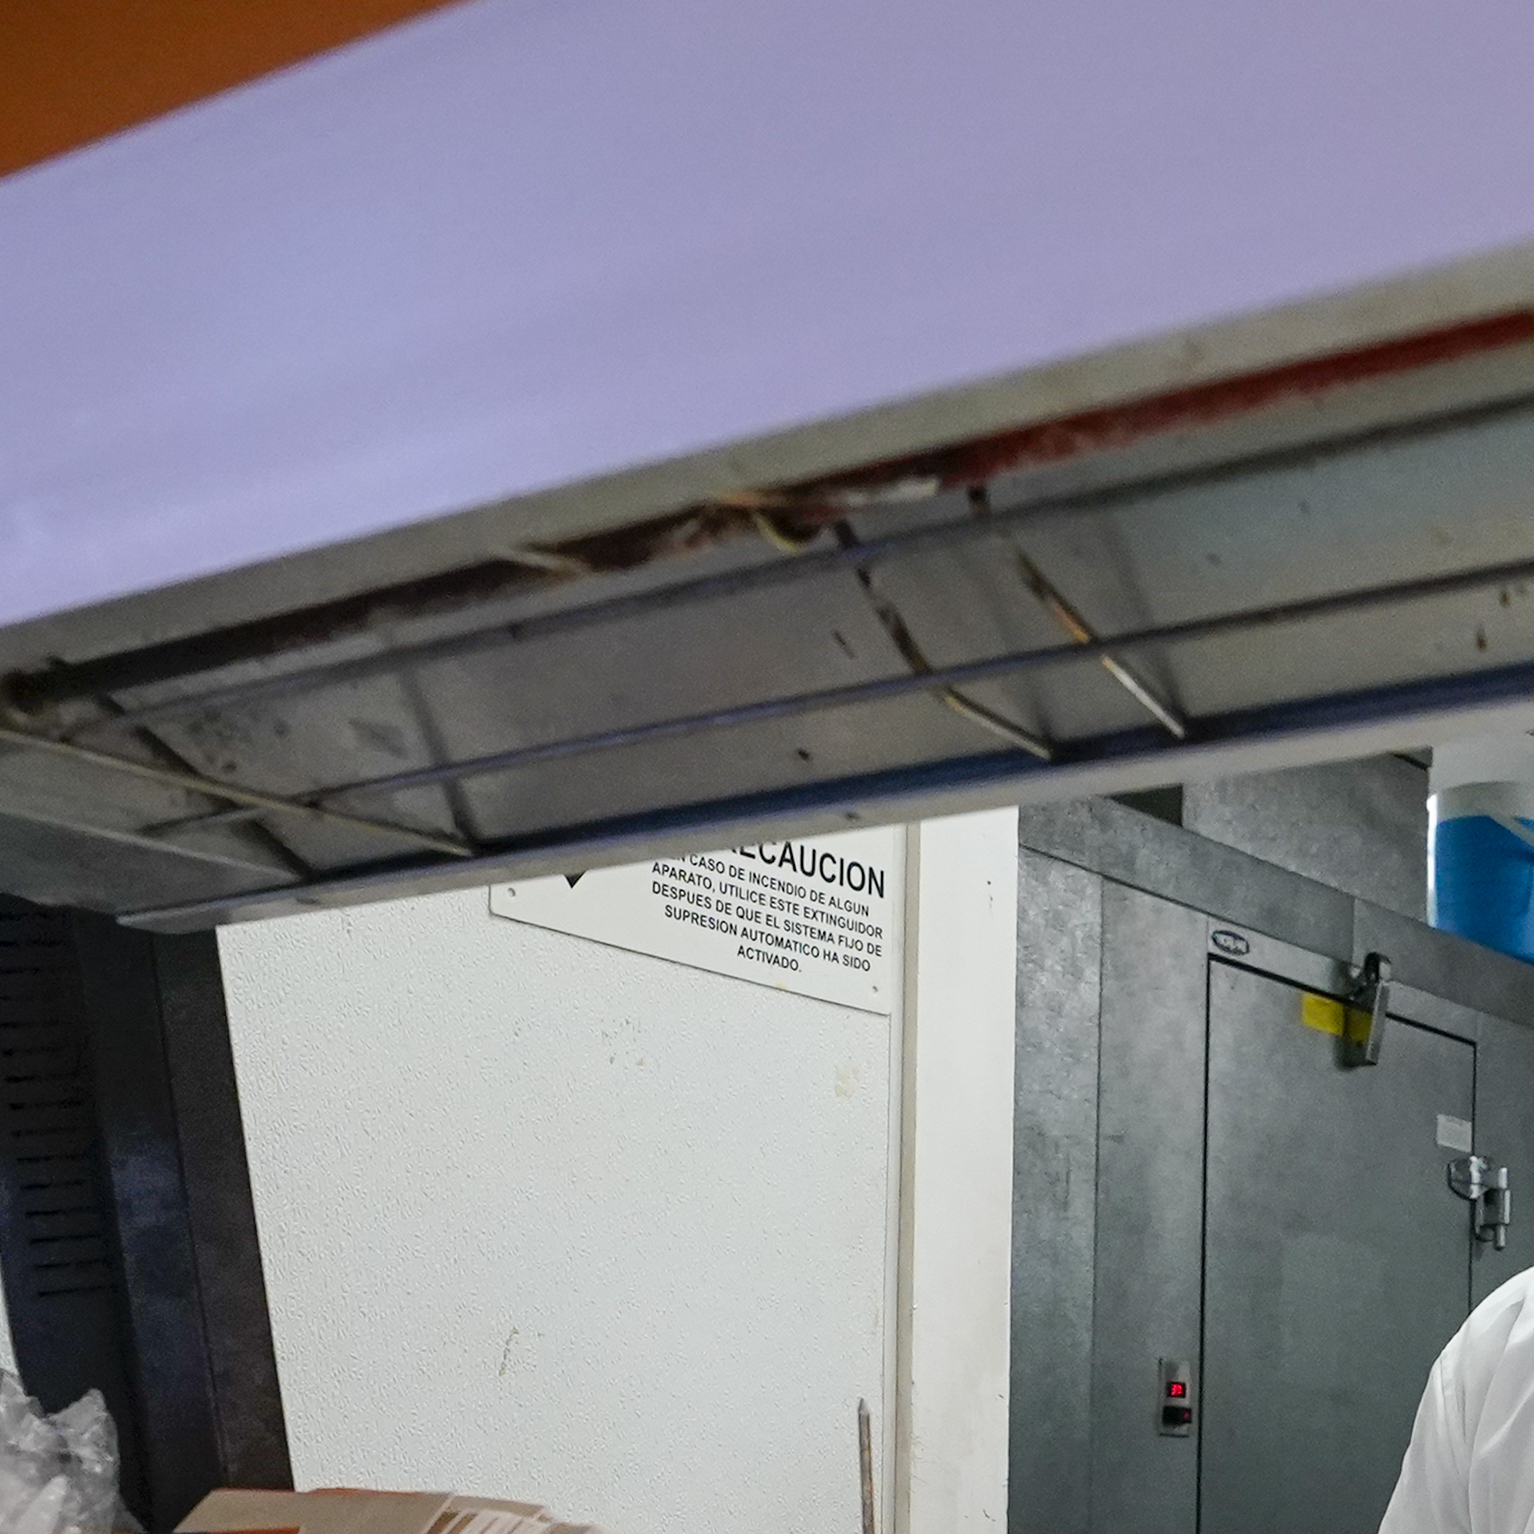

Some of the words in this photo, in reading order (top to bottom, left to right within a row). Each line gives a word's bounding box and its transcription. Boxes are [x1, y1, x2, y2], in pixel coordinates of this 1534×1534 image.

[652, 861, 716, 893] APARATO,
[719, 881, 766, 906] UTILICE
[770, 896, 800, 916] ESTE
[803, 906, 883, 939] EXTINGUIDOR
[690, 853, 725, 874] CASO
[728, 864, 745, 881] DE
[749, 871, 806, 899] INCENDIO
[810, 889, 826, 905] DE
[828, 896, 869, 917] ALGUN
[731, 840, 885, 898] CAUCION
[652, 881, 712, 910] DESPUES
[715, 900, 732, 915] DE
[736, 906, 762, 924] QUE
[765, 914, 781, 929] EL
[783, 919, 835, 944] SISTEMA
[838, 934, 864, 951] FIJO
[867, 942, 882, 957] DE
[665, 904, 738, 935] SUPRESION
[740, 927, 820, 958] AUTOMATICO
[823, 949, 839, 964] HA
[842, 954, 871, 972] SIDO
[737, 945, 802, 973] ACTIVADO.
